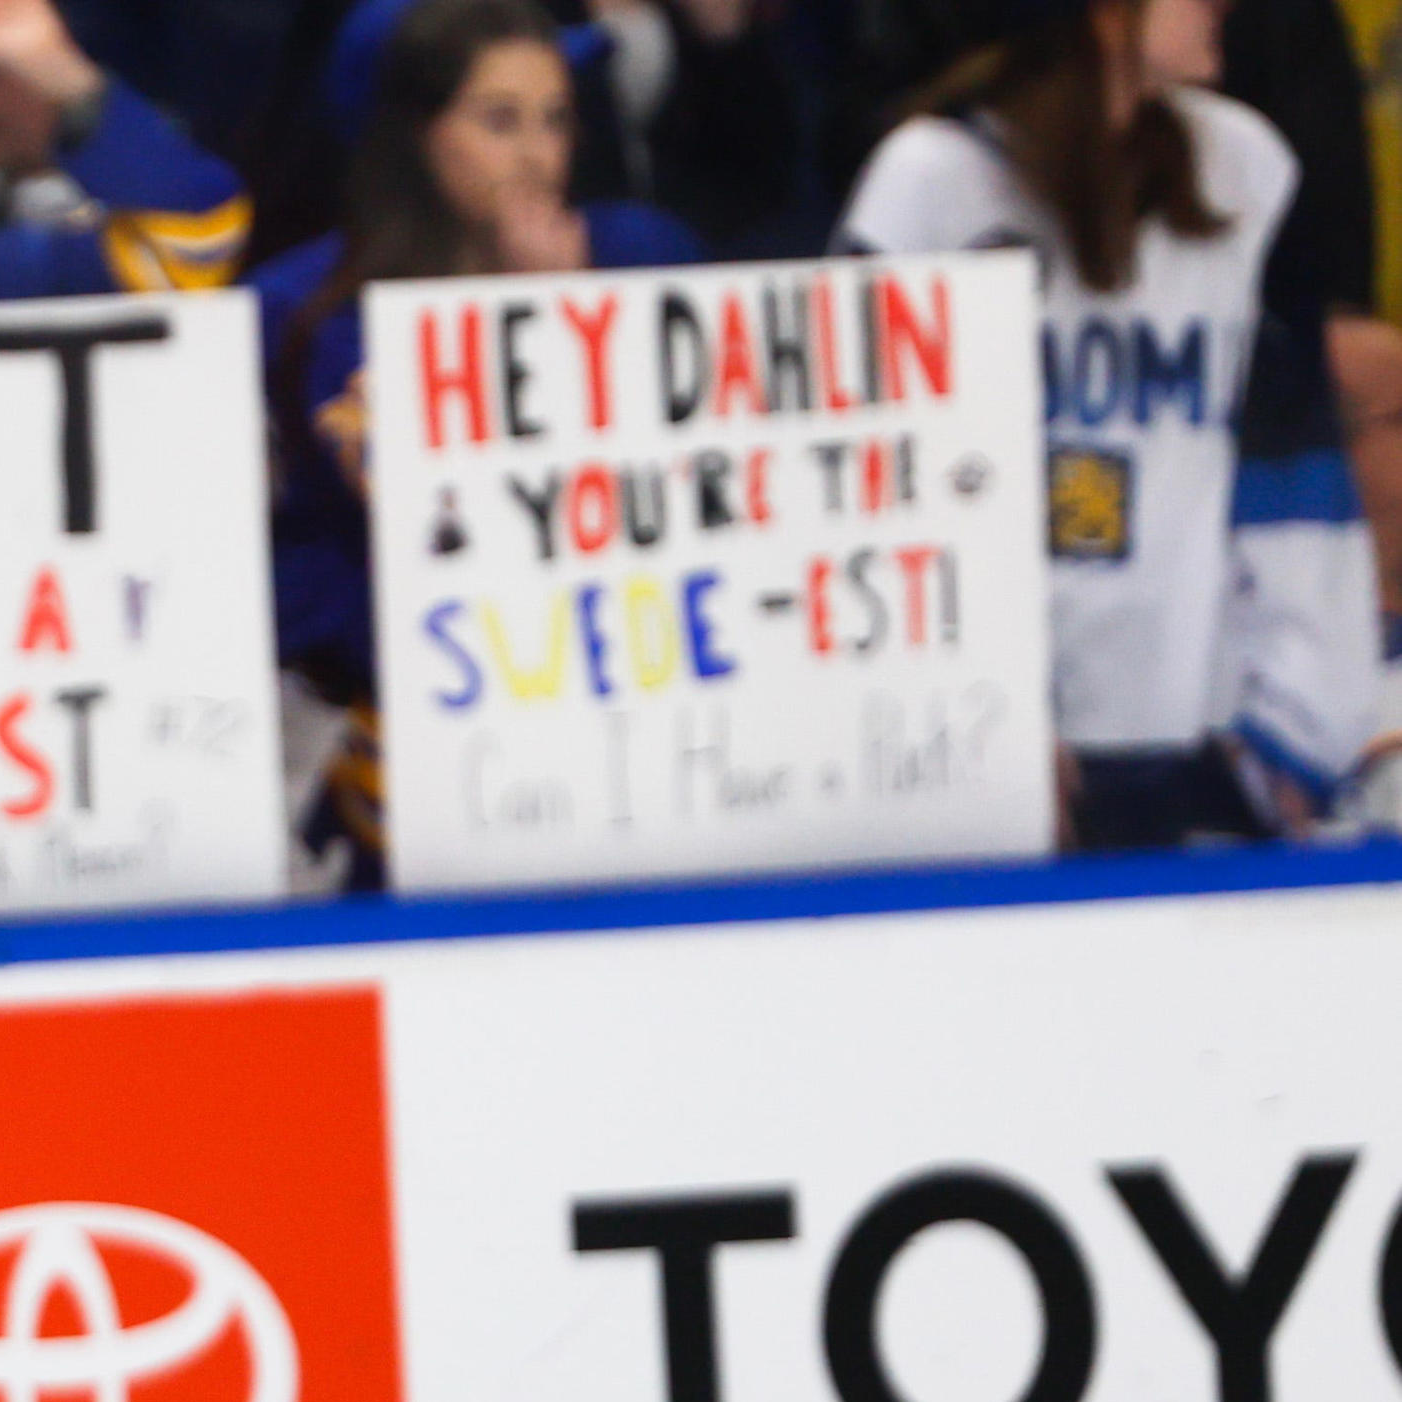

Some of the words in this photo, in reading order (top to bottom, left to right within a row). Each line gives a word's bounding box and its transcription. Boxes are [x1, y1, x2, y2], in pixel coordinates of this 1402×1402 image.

[418, 295, 618, 447] HEY
[660, 272, 954, 424] DAHLIN
[504, 447, 773, 560] YOU'RE
[18, 562, 74, 654] A
[422, 570, 740, 710] SWEDE
